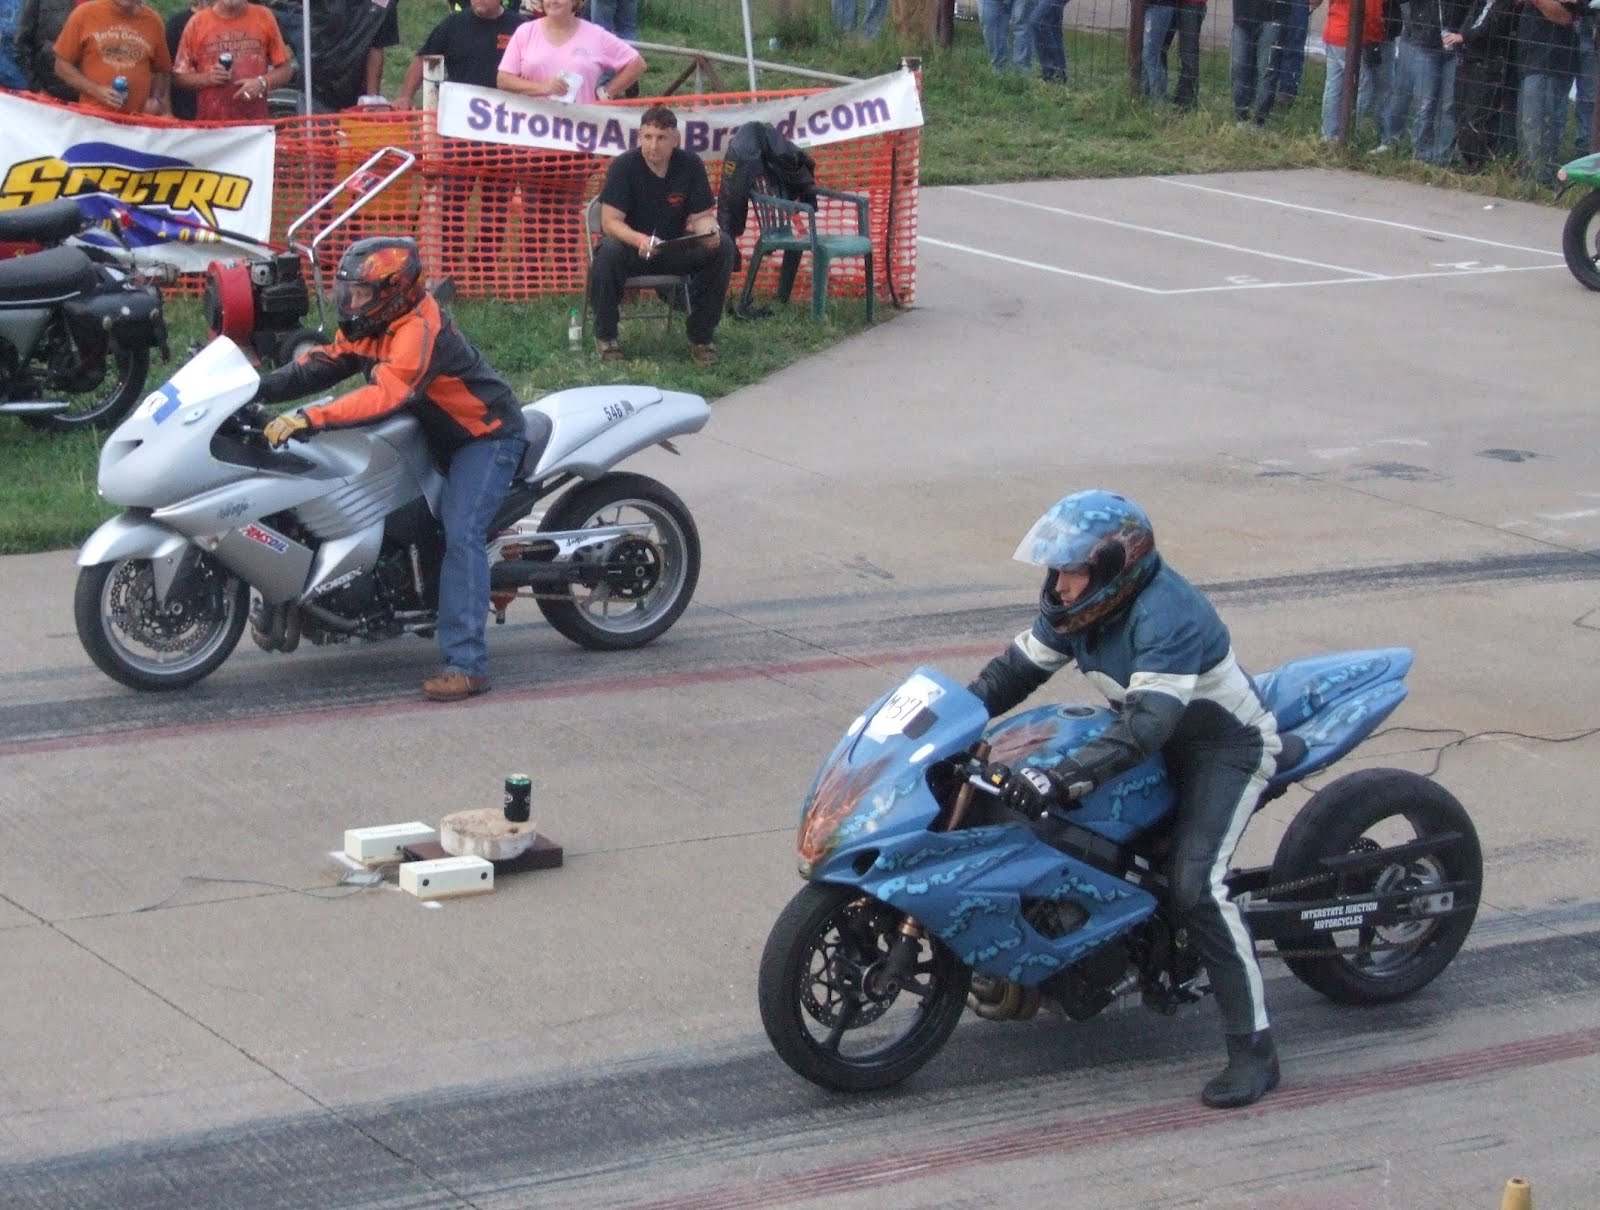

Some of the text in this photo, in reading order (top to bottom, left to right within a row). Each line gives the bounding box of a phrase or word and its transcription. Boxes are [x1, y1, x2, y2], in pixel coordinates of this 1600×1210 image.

[0, 156, 253, 228] SPECTRO
[1301, 902, 1378, 920] INTERSTATE JUNCTION
[1313, 915, 1363, 929] MOTORCYCLES
